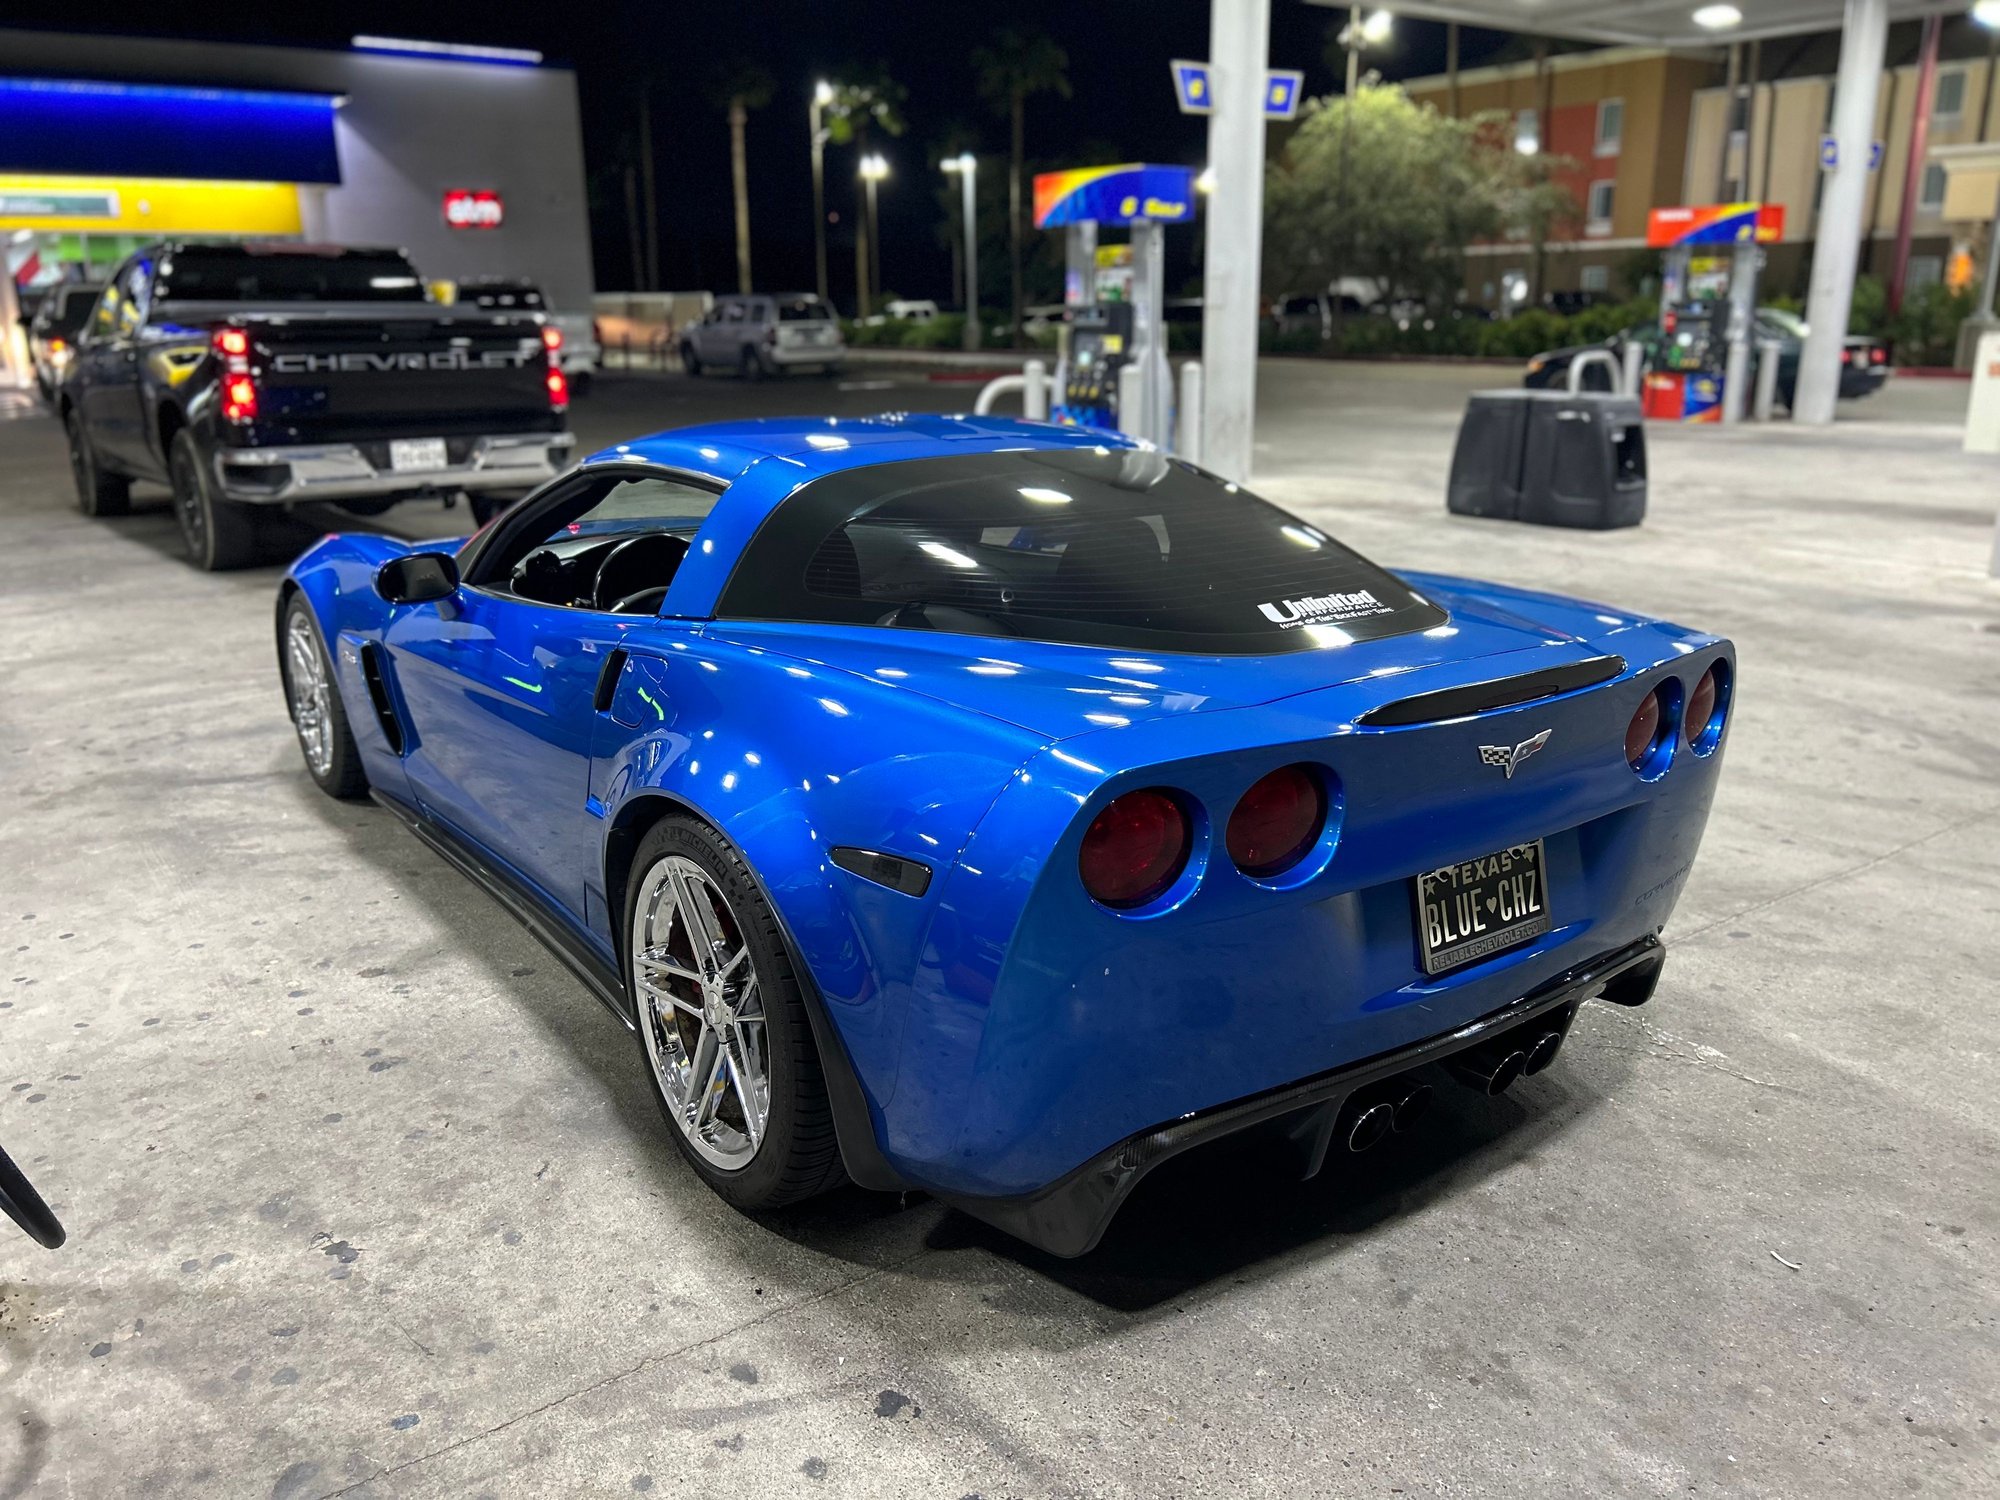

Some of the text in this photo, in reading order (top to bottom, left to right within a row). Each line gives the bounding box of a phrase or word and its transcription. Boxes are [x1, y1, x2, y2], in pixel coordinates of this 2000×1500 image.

[274, 349, 532, 374] CHEVROLET
[1257, 589, 1378, 623] Unlimited
[1300, 601, 1385, 618] PERFORMANCE
[679, 828, 729, 881] MICHELIN
[1450, 852, 1512, 888] TEXAS
[1426, 870, 1541, 948] BLUE CHZ
